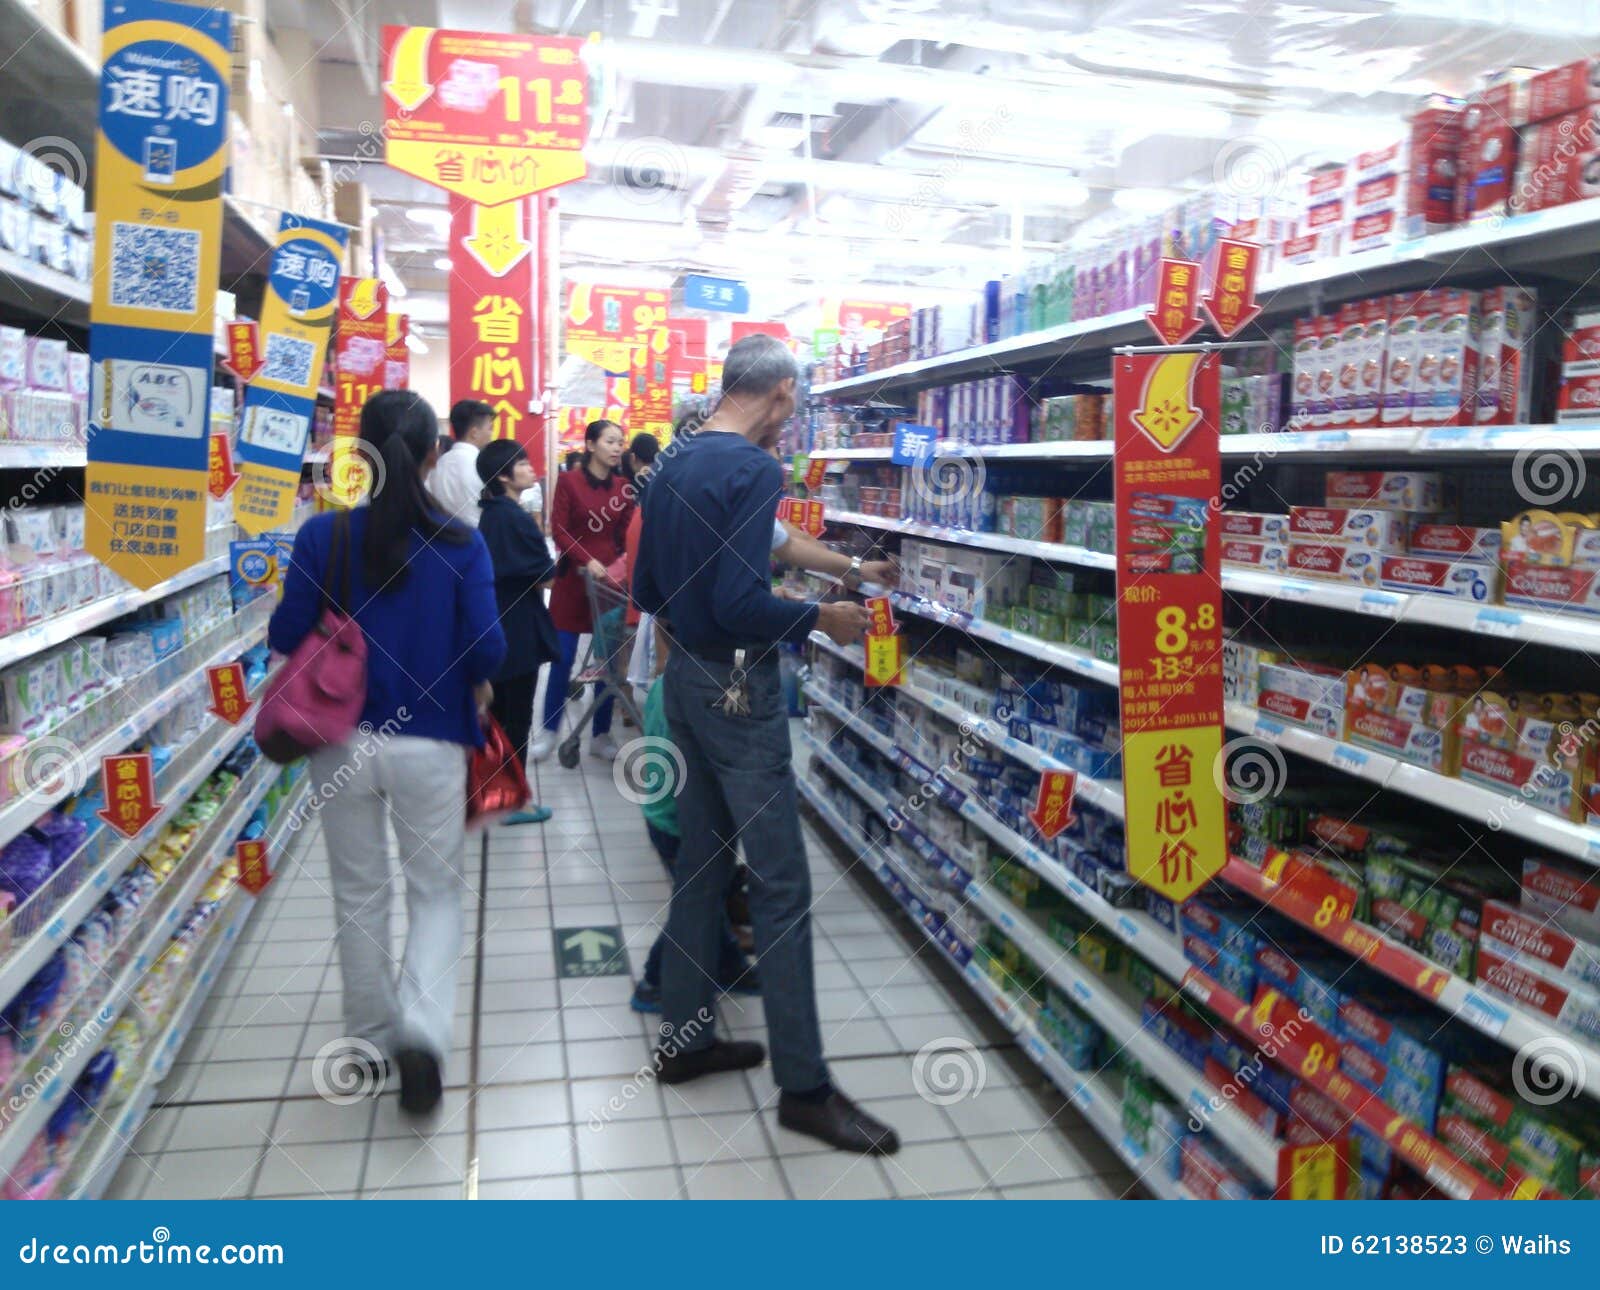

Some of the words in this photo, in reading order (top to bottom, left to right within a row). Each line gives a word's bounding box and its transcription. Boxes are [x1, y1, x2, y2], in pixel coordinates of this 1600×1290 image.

[106, 65, 219, 126] 速购
[435, 150, 540, 186] 省心价
[277, 250, 337, 288] 速购
[139, 373, 182, 387] ABC
[900, 432, 929, 458] 新
[113, 504, 179, 522] 送货到家
[1297, 515, 1335, 531] Colgate
[1391, 567, 1433, 583] Colgate
[1511, 573, 1571, 597] Colgate
[1155, 603, 1216, 654] 8.8
[1266, 697, 1298, 715] Colgate
[1355, 717, 1395, 740] Colgate
[1467, 751, 1515, 778] Colgate
[116, 760, 143, 821] 省心价
[1154, 744, 1198, 885] 省心价
[1491, 918, 1553, 958] Colgate
[1487, 965, 1547, 1006] Colgate
